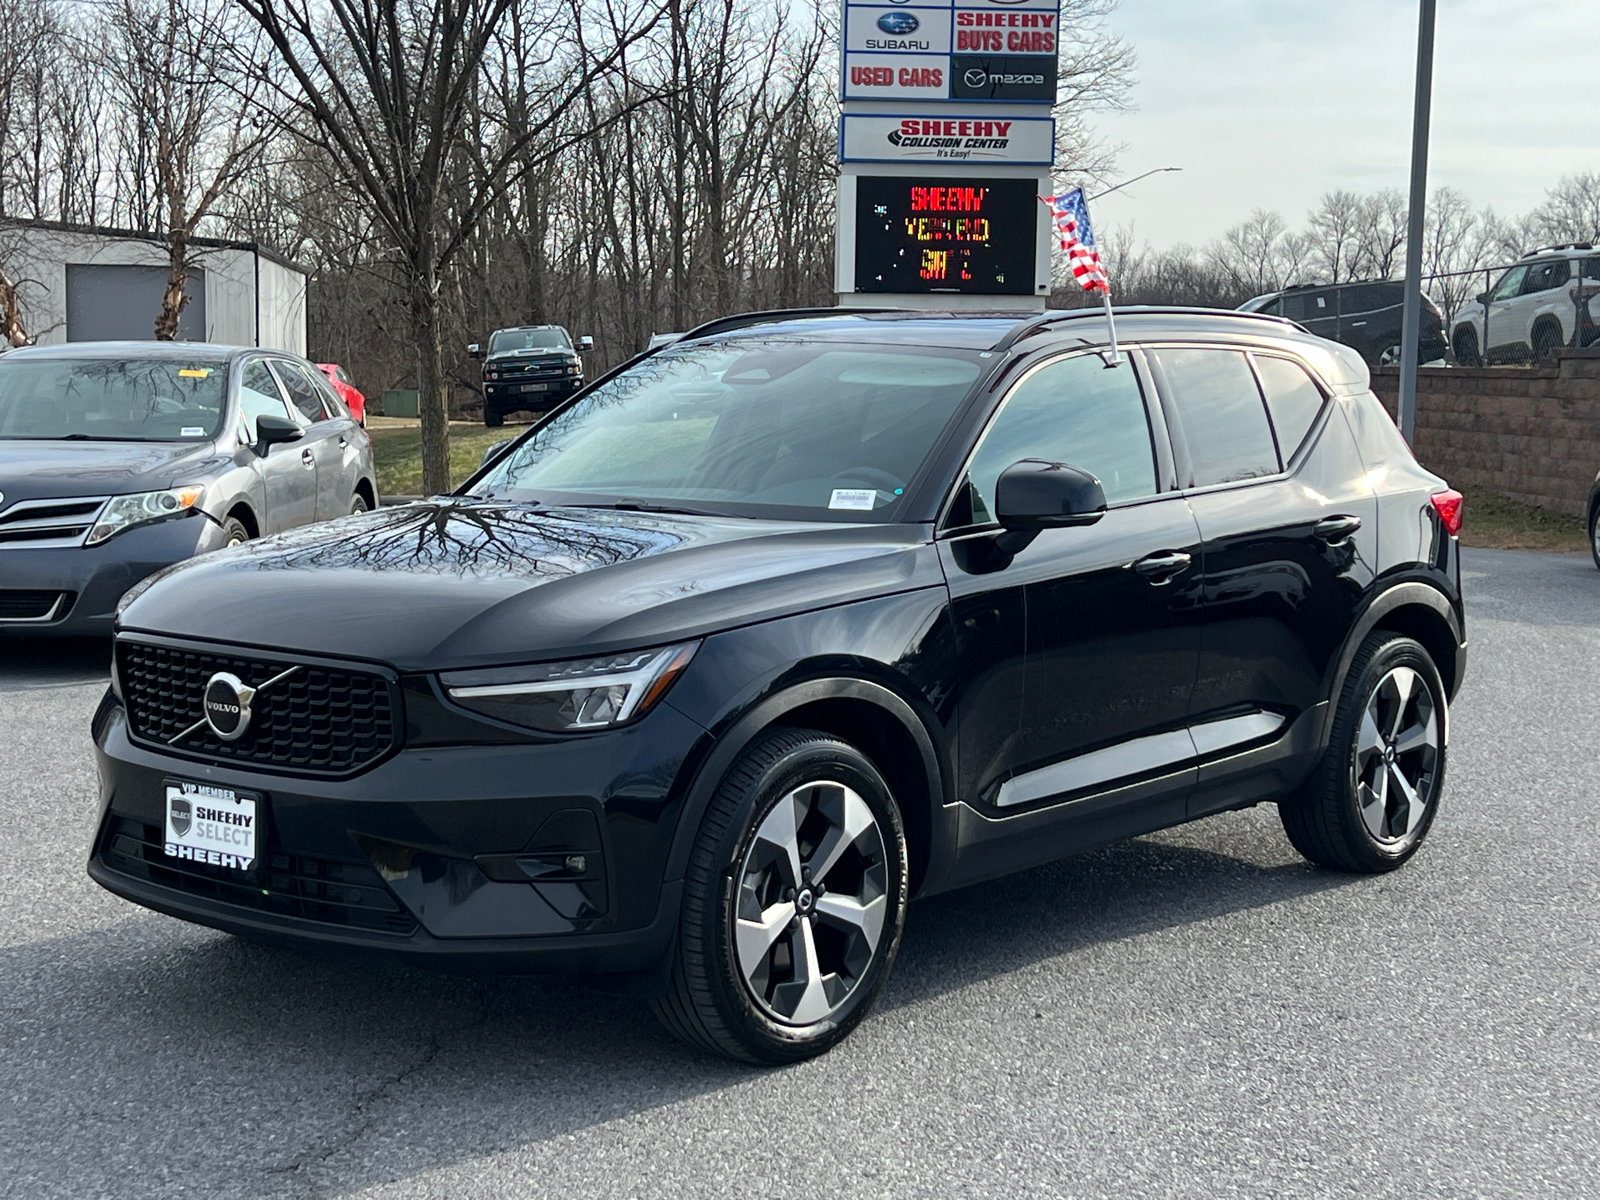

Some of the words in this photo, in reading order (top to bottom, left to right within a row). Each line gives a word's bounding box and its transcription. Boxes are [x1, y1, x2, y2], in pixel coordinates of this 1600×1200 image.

[956, 12, 1056, 28] SHEEHY
[865, 39, 930, 50] SUBARU
[957, 30, 1003, 51] BUYS
[1007, 31, 1055, 52] CARS
[851, 66, 894, 86] USED
[898, 68, 943, 87] CARS
[989, 74, 1045, 85] mazda
[900, 120, 1012, 137] SHEEHY
[900, 137, 962, 148] COLLISION
[964, 138, 1009, 149] CENTER
[936, 149, 948, 158] It's
[949, 149, 971, 160] Easy!
[207, 701, 239, 714] VOLVO
[182, 782, 196, 794] VIP
[198, 785, 236, 800] MEMBER
[196, 806, 253, 828] SHEEHY
[196, 821, 252, 847] SELECT
[164, 843, 253, 871] SHEEHY
